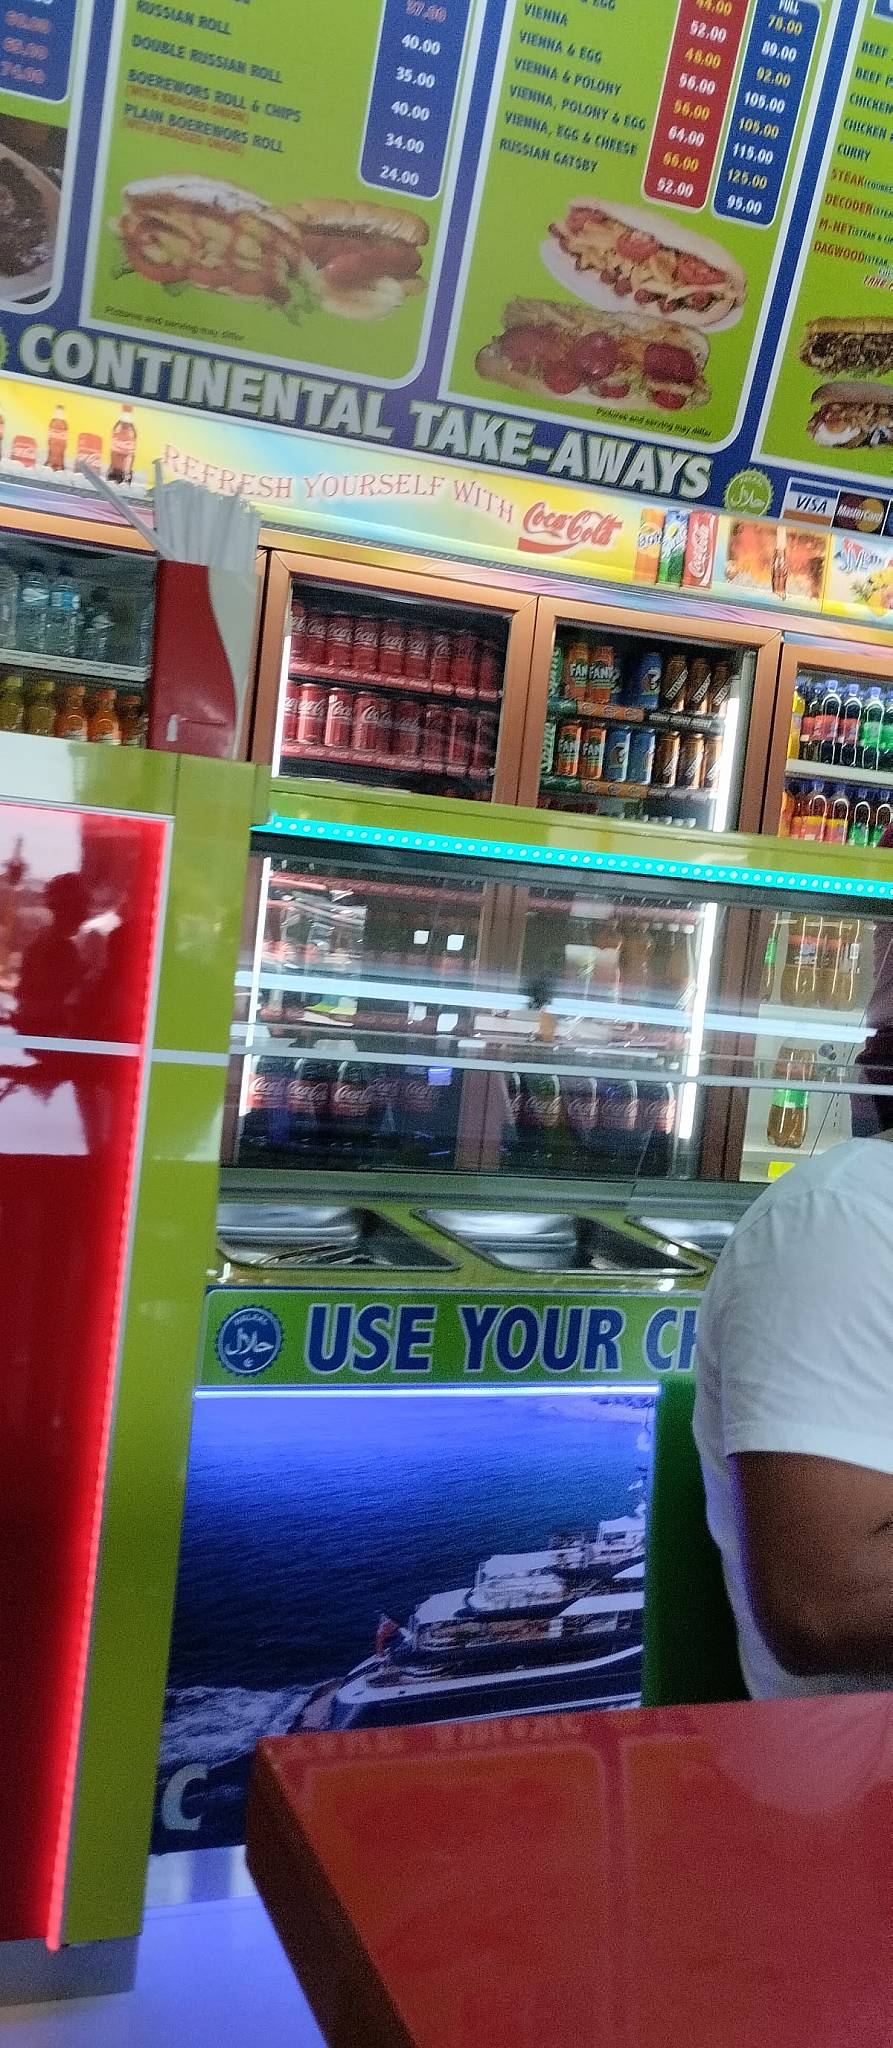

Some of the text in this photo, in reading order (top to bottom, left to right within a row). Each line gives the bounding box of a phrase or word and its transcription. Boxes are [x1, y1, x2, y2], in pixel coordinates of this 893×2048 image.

[136, 0, 232, 35] RUSSIAN ROLL
[524, 4, 568, 27] VIENNA
[690, 20, 727, 43] 52.00
[401, 34, 441, 55] 40.00
[520, 31, 602, 64] VIENNA & EGG
[132, 34, 283, 83] DOUBLE RUSSIAN ROLL
[396, 66, 436, 88] 35.00
[514, 57, 622, 96] VIENNA & POLONY
[214, 90, 246, 109] ROLL
[265, 103, 301, 123] CHIPS
[391, 100, 431, 121] 40.00
[510, 84, 646, 131] VIENNA, POLONY & EGG
[849, 92, 893, 114] CHICKEN
[124, 103, 164, 124] PLAIN
[252, 134, 284, 153] ROLL
[505, 111, 637, 156] VIENNA, EGG & CHEESE
[668, 125, 704, 147] 64.00
[843, 118, 887, 140] CHICKEN
[385, 132, 425, 153] 34.00
[837, 143, 871, 162] CURRY
[500, 138, 598, 173] RUSSIAN GATSBY
[380, 165, 420, 186] 24.00
[832, 168, 864, 187] STEAK
[657, 177, 693, 198] 52.00
[825, 192, 873, 215] DECODER
[813, 240, 864, 263] DAGWOOD
[19, 323, 715, 500] CONTINENTAL TAKE-AWAYS
[163, 444, 293, 499] REFRESH
[304, 472, 445, 498] YOURSELF
[453, 479, 514, 524] WITH
[796, 495, 828, 514] VISA
[836, 503, 884, 522] MasterCard
[308, 1304, 438, 1373] USE
[458, 1304, 626, 1374] YOUR
